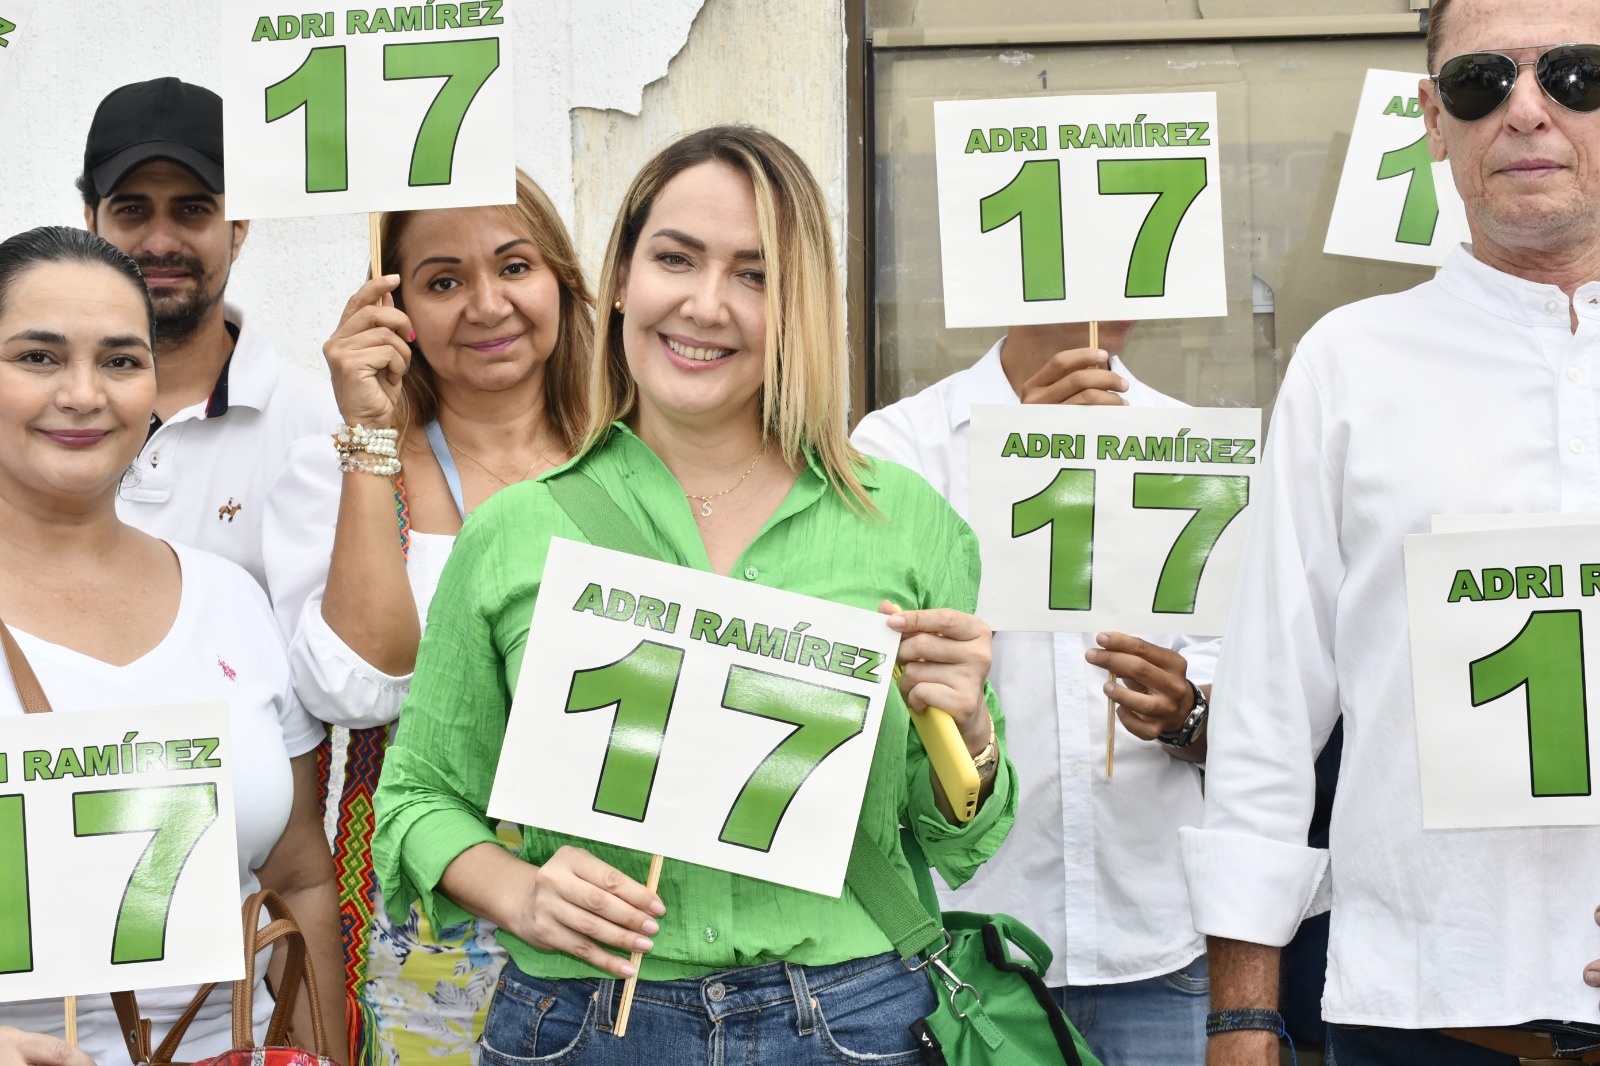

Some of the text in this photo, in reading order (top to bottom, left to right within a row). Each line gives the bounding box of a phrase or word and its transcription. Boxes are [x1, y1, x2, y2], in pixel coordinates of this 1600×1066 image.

[252, 0, 504, 42] ADRI RAMÍREZ
[265, 37, 500, 193] 17
[965, 114, 1211, 154] ADRI RAMÍREZ
[980, 158, 1208, 302] 17
[1001, 429, 1256, 465] ADRI RAMÍREZ
[1012, 468, 1249, 615] 17
[1447, 564, 1564, 603] ADRI
[573, 582, 887, 683] ADRI RAMÍREZ
[564, 639, 871, 853] 17
[1468, 608, 1592, 798] 1
[24, 731, 221, 782] RAMÍREZ
